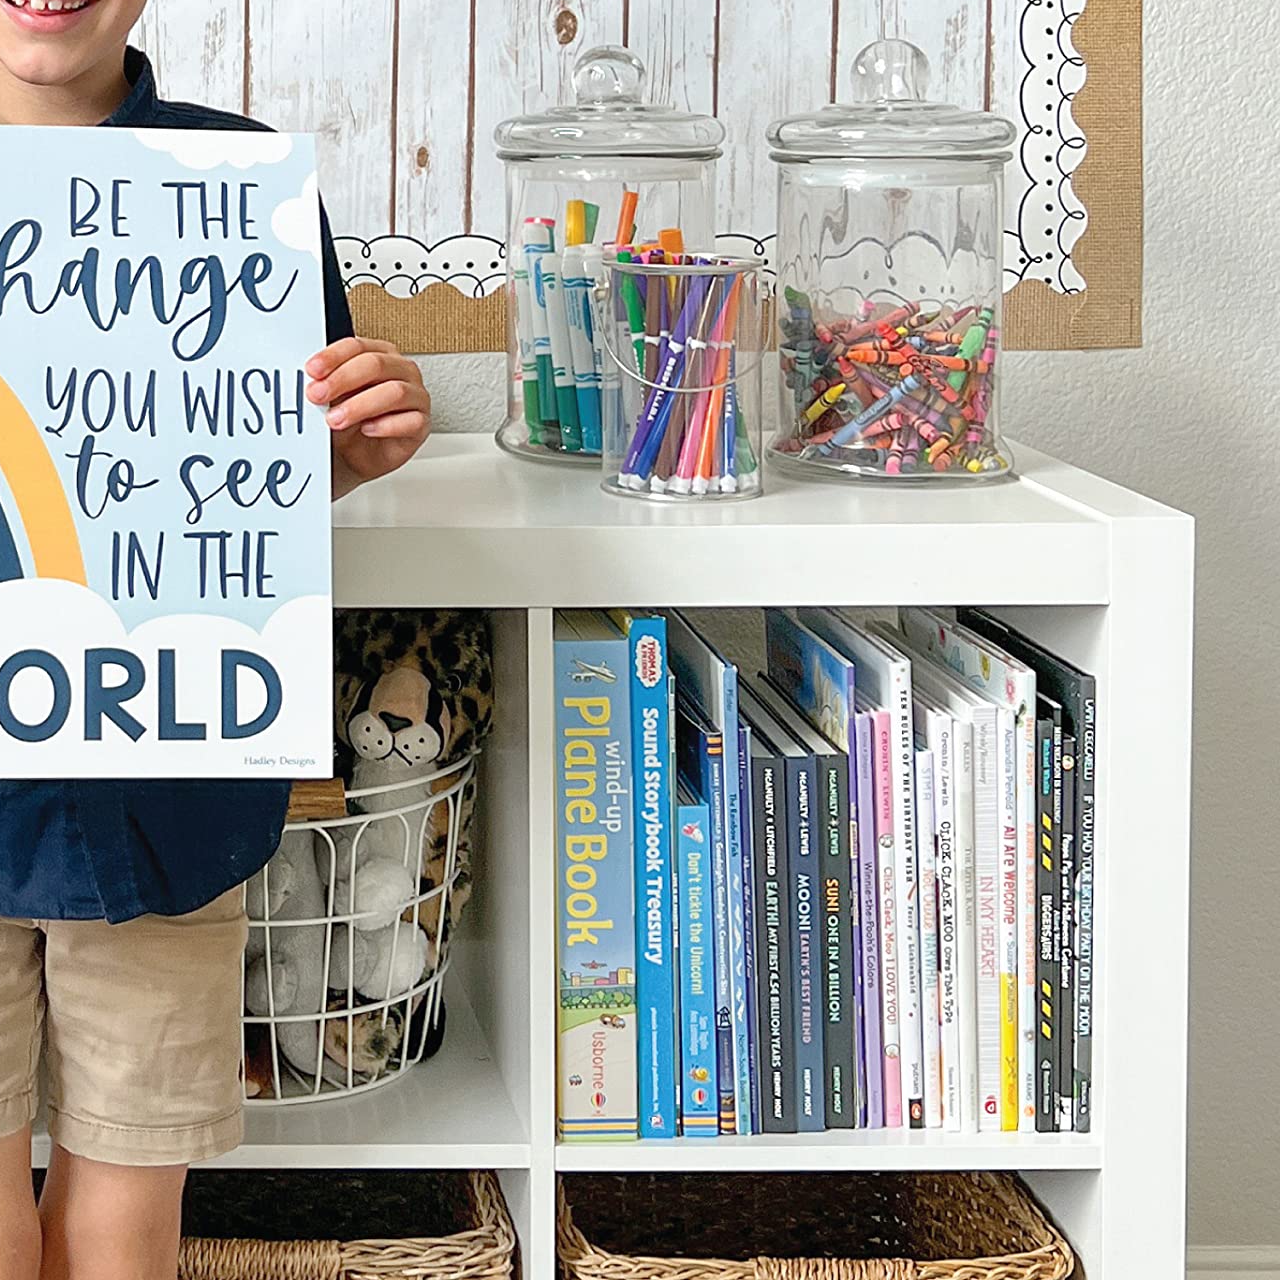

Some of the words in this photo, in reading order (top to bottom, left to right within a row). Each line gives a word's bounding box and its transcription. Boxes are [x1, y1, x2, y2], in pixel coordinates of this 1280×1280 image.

[70, 178, 132, 238] BE
[162, 181, 259, 240] THE
[46, 366, 157, 438] YOU
[184, 369, 306, 437] WISH
[65, 434, 160, 519] to
[181, 457, 311, 525] see
[112, 531, 164, 601] IN
[185, 530, 279, 599] THE
[243, 754, 277, 768] Hadley
[278, 754, 317, 768] Designs
[563, 697, 611, 824] Plane
[643, 708, 662, 768] Sound
[599, 741, 628, 832] wind-up
[641, 771, 664, 872] Storybook
[687, 851, 703, 883] Don't
[1003, 845, 1016, 867] Are
[565, 834, 613, 946] Book
[687, 886, 703, 920] tickle
[978, 876, 994, 894] IN
[980, 896, 995, 923] MY
[1003, 872, 1016, 926] Welcome
[644, 875, 663, 965] Treasury
[689, 921, 703, 944] the
[980, 925, 996, 978] HEART
[828, 972, 841, 1022] BILLION
[591, 1030, 607, 1090] Usborne
[771, 1038, 782, 1068] YEARS
